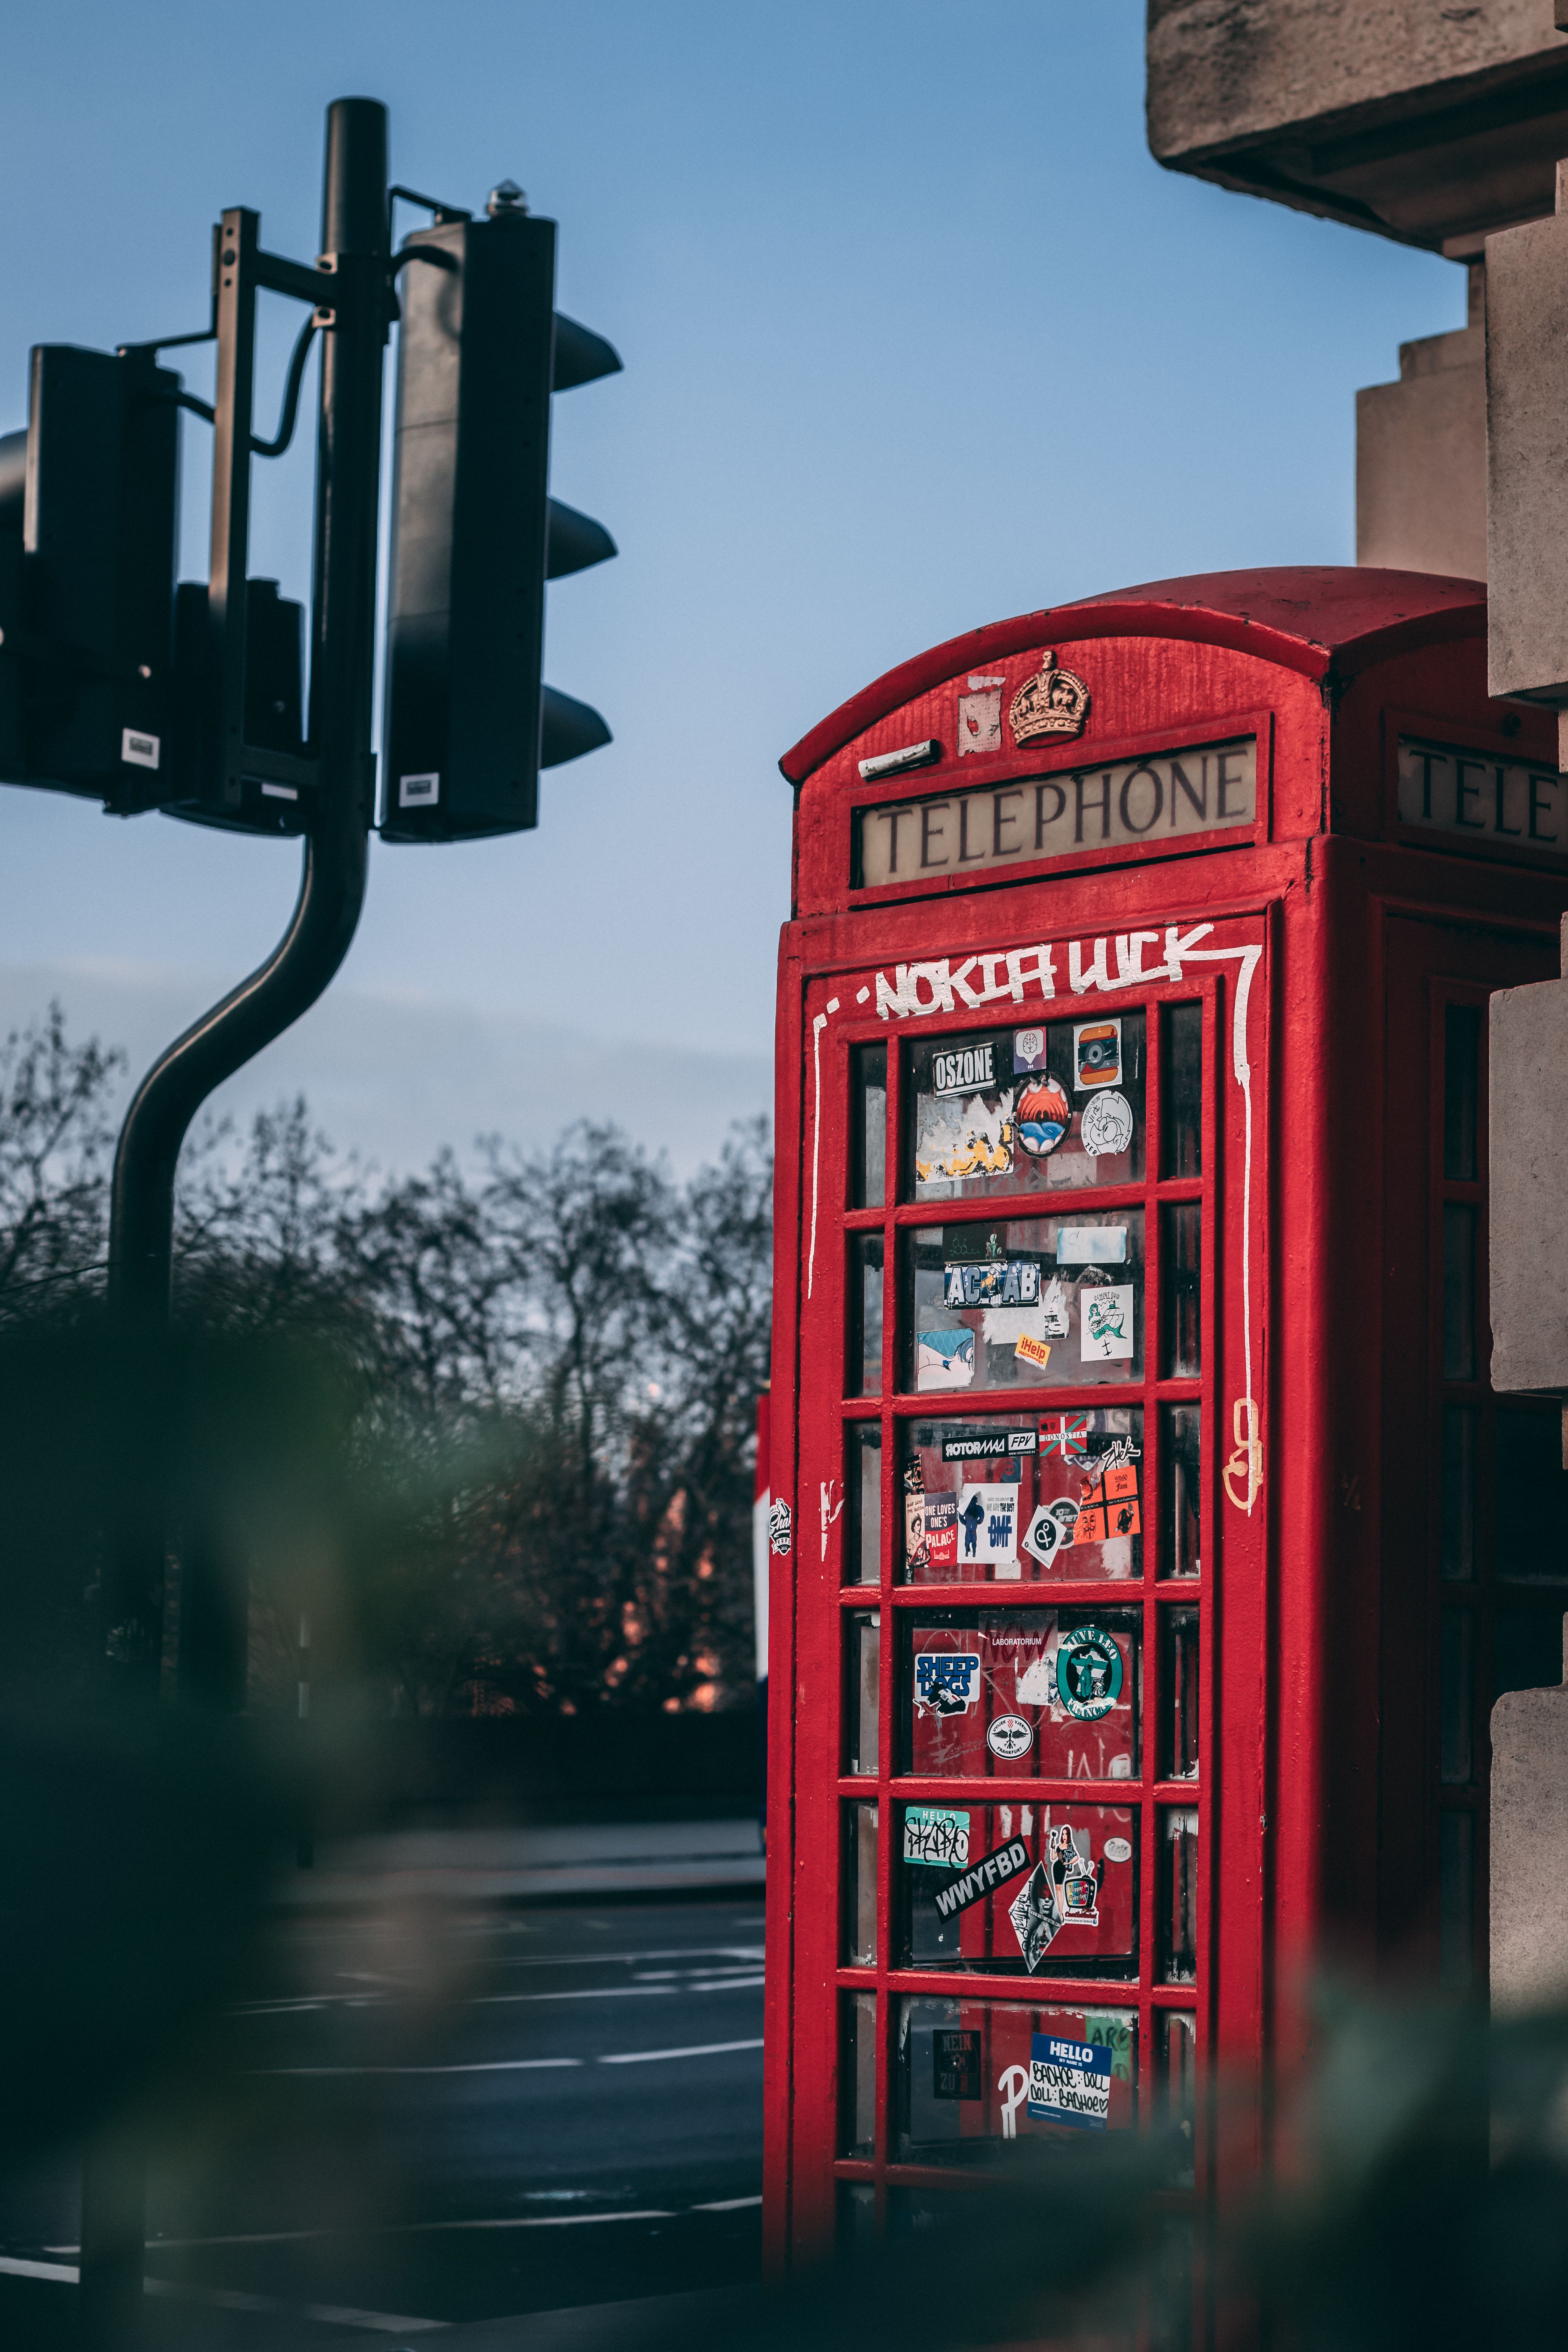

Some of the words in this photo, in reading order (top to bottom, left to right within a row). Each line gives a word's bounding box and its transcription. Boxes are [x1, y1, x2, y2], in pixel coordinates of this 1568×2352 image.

[1409, 749, 1558, 842] TELE
[878, 750, 1248, 873] TELEPHONE
[876, 941, 1057, 1020] NOKIA
[936, 1047, 993, 1089] OSZONE
[1021, 1337, 1045, 1359] iHelp
[1011, 1435, 1033, 1448] FPV
[1044, 1432, 1082, 1441] DONOSTIA
[925, 1505, 936, 1516] ONE
[937, 1503, 955, 1515] LOVES
[931, 1516, 947, 1528] ONE'S
[926, 1530, 955, 1549] PALACE
[1067, 1630, 1096, 1653] JUVE
[1098, 1633, 1118, 1660] LEO
[916, 1656, 979, 1676] SHEEP
[916, 1676, 971, 1697] DOGS
[993, 1720, 1006, 1732] UVIJEK
[1014, 1720, 1028, 1732] VJERNI
[997, 1746, 1023, 1755] FRANKFURT
[923, 1810, 956, 1821] HELLO
[935, 1843, 1025, 1916] WWYFBD
[942, 2033, 972, 2052] NEIN
[1050, 2041, 1093, 2063] HELLO
[941, 2073, 956, 2091] ZU
